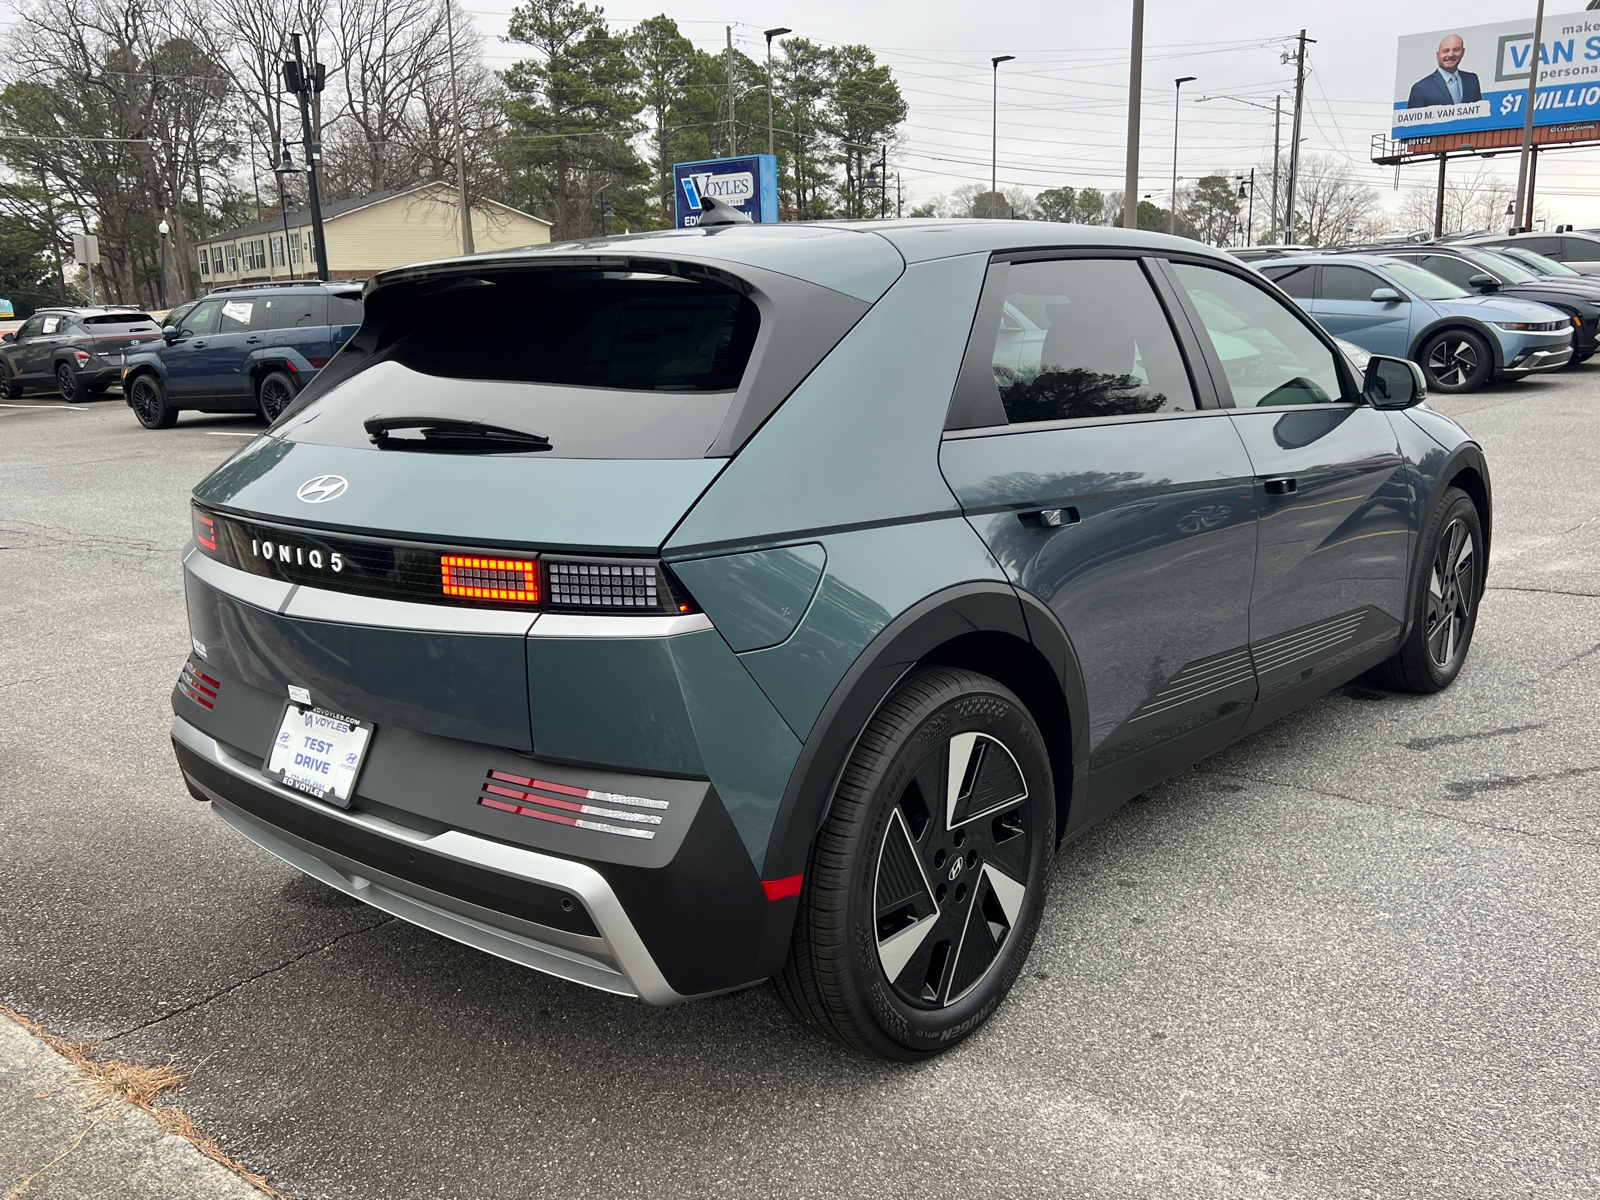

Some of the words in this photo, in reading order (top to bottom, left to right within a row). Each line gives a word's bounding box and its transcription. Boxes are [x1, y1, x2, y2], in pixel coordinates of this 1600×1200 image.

[1510, 39, 1575, 68] VAN
[1540, 65, 1600, 82] persona
[1500, 93, 1522, 116] $1
[1533, 86, 1600, 111] MILLIO
[1397, 112, 1422, 123] DAVID
[1424, 111, 1434, 120] M.
[1437, 108, 1455, 118] VAN
[1456, 105, 1480, 116] SANT
[692, 175, 749, 197] VOYLES
[252, 539, 323, 569] IONIQ
[330, 552, 343, 573] 5
[315, 715, 349, 734] VOYLES
[304, 736, 334, 755] TEST
[294, 752, 331, 775] DRIVE
[282, 776, 294, 786] ED
[295, 780, 324, 798] VOYLES
[938, 995, 996, 1041] CRUGEN
